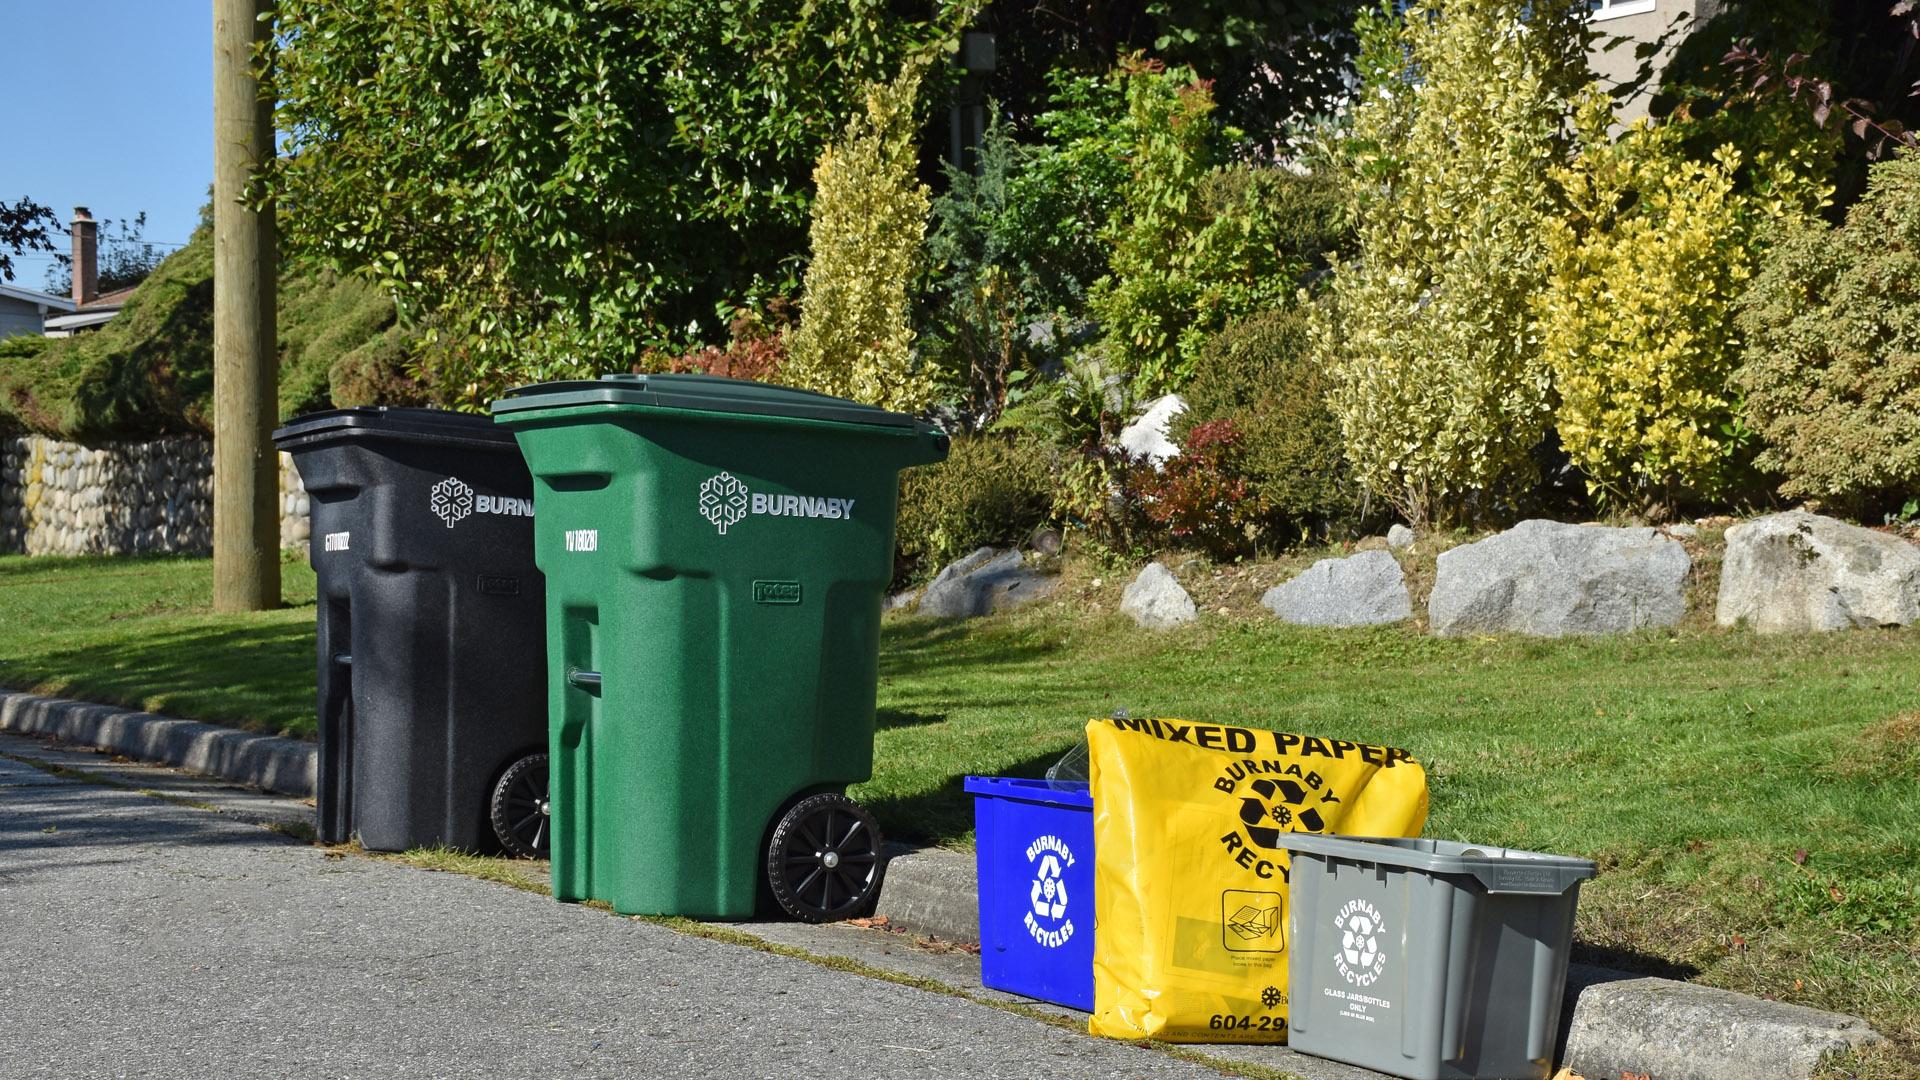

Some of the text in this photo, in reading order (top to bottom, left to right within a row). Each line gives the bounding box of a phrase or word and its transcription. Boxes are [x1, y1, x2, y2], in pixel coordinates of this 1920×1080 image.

[752, 493, 855, 519] BURNABY
[1113, 718, 1417, 769] MIXED PAPER
[1214, 759, 1341, 804] BURNABY
[1026, 835, 1075, 868] BURNABY
[1024, 910, 1074, 948] RECYCLES
[1334, 899, 1386, 933] BURNABY
[1334, 952, 1386, 987] RECYCLES
[1324, 988, 1346, 999] GLASS
[1349, 1003, 1367, 1013] ONLY
[1209, 1014, 1288, 1032] 604-29
